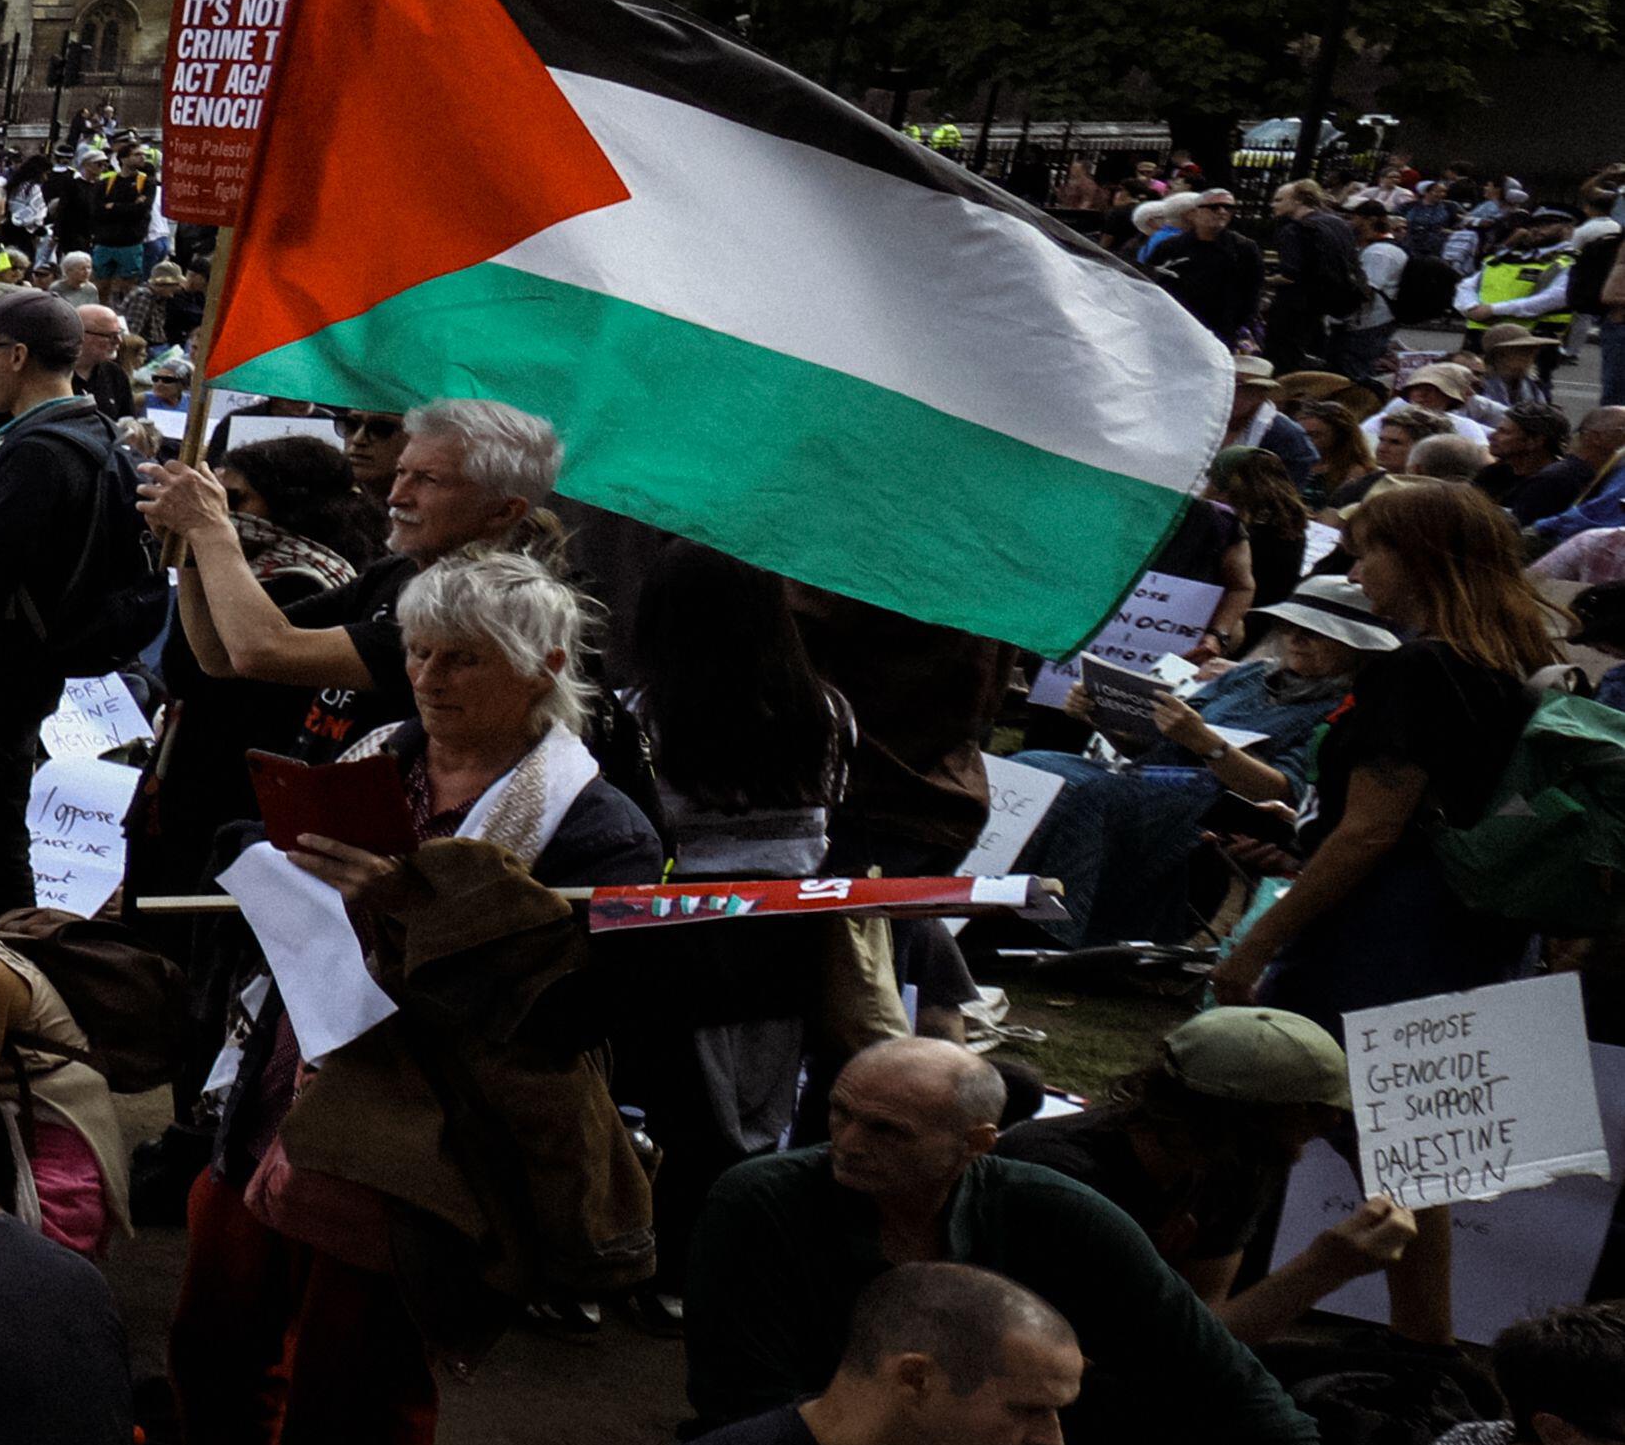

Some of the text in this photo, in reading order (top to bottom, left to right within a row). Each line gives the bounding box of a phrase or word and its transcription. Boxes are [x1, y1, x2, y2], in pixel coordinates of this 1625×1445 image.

[177, 29, 260, 62] CRIME
[172, 62, 220, 95] ACT
[54, 803, 115, 832] oppose
[1368, 1051, 1490, 1091] GENOCIDE
[1406, 1077, 1510, 1116] SUPPORT
[1375, 1120, 1518, 1176] PALESTINE
